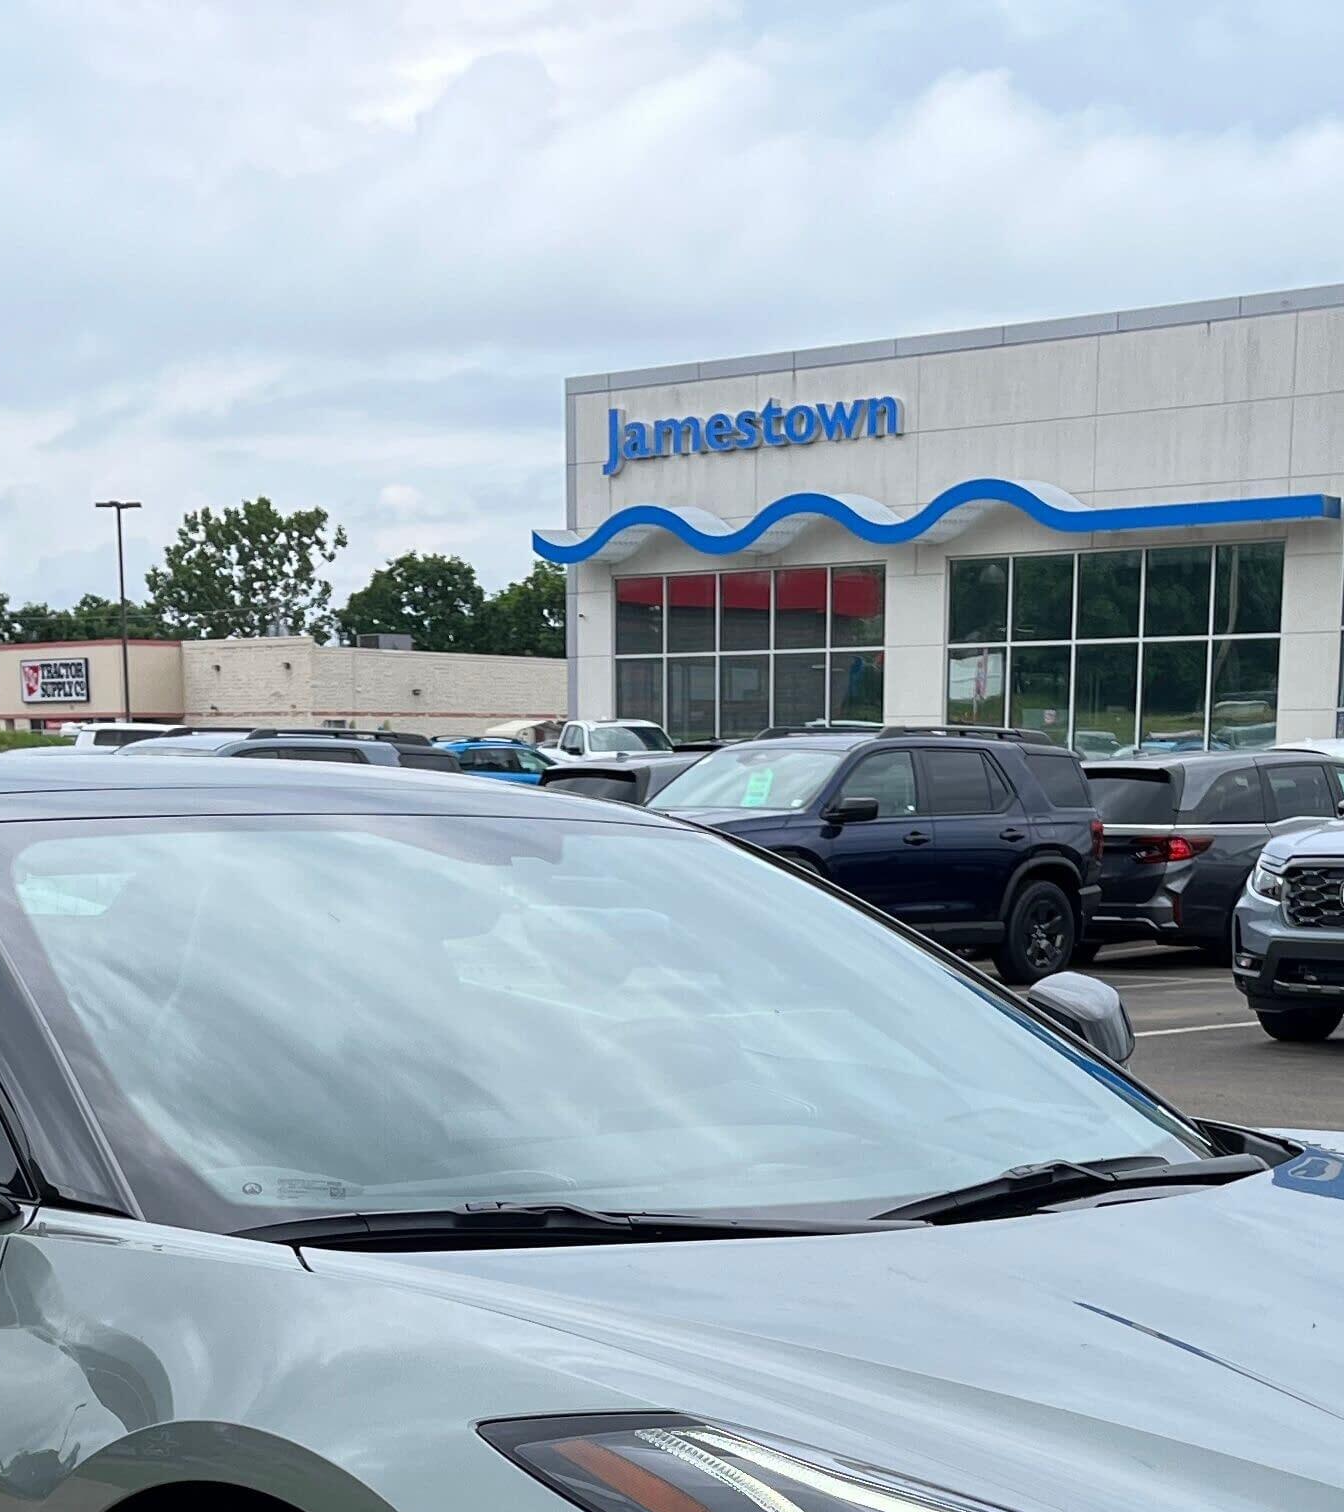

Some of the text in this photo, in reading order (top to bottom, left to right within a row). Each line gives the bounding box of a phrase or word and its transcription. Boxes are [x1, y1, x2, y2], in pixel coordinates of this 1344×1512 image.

[602, 396, 903, 476] Jamestown
[40, 662, 85, 680] TRACTOR
[40, 681, 74, 698] SUPPLY
